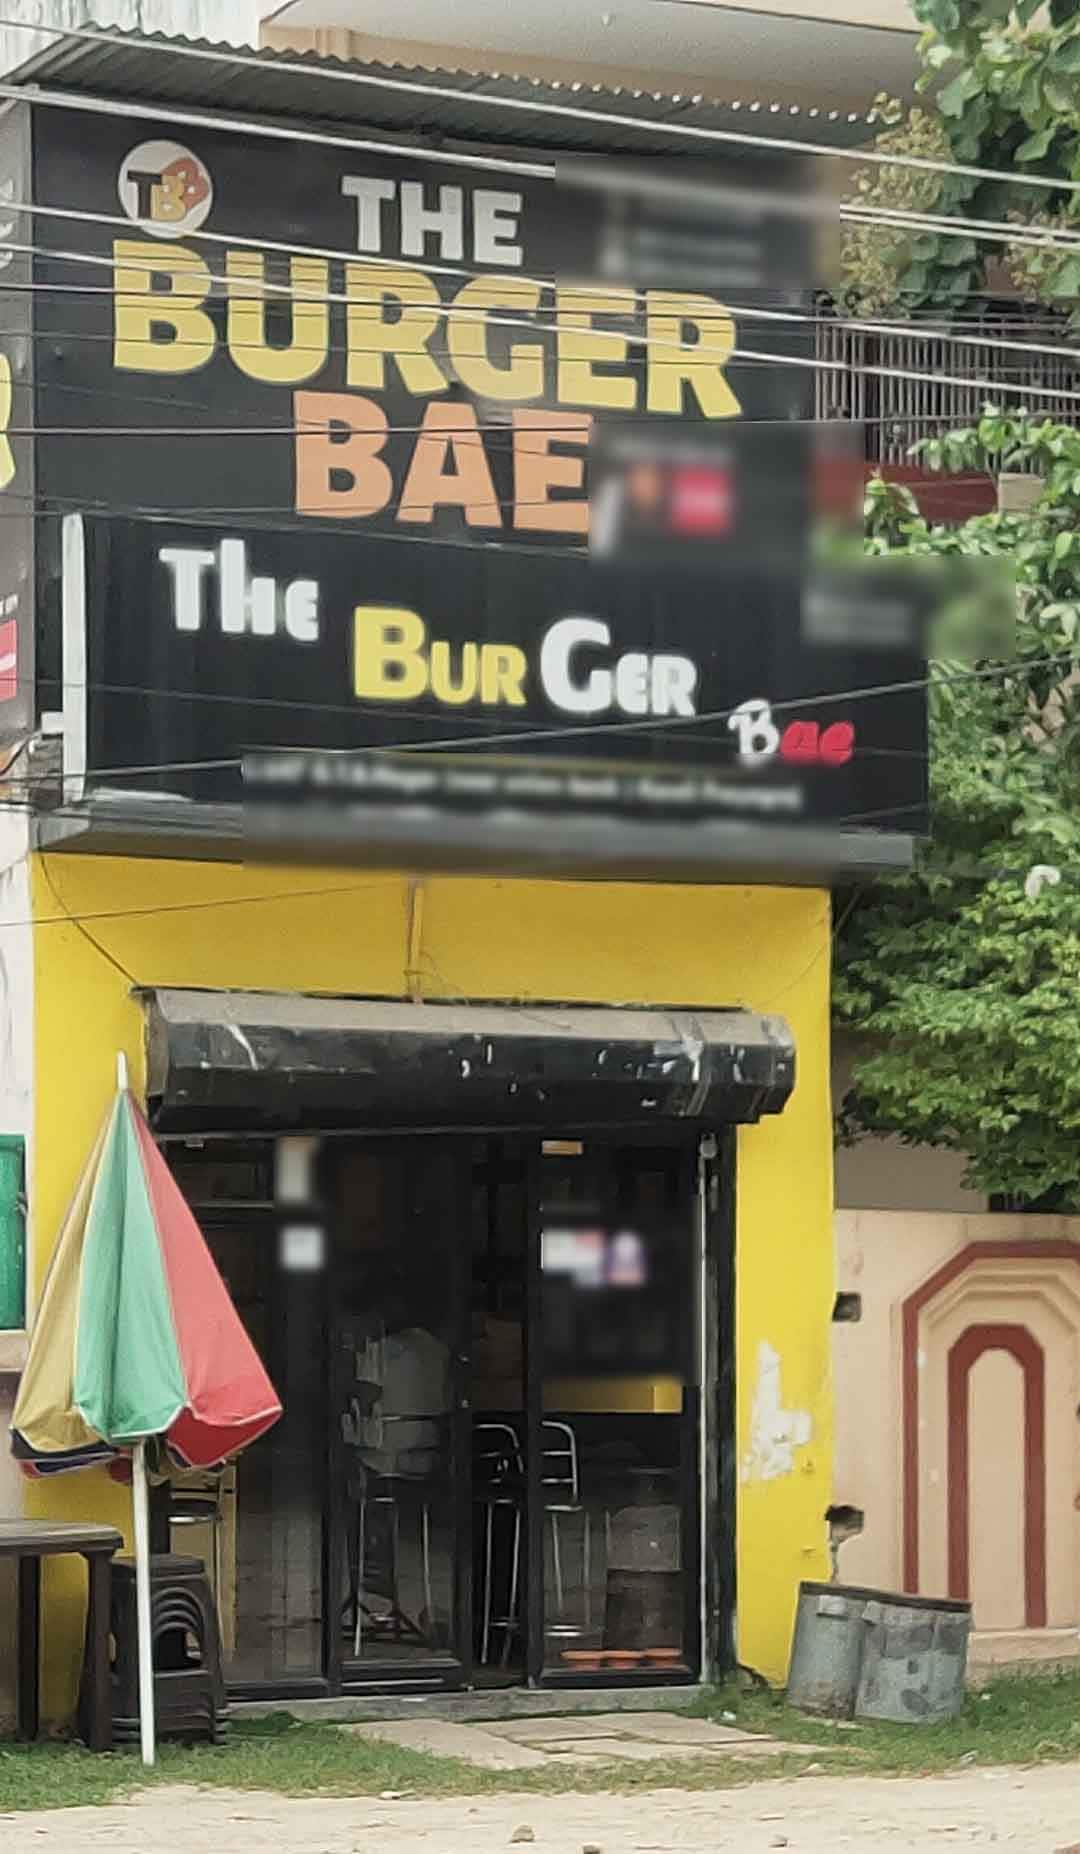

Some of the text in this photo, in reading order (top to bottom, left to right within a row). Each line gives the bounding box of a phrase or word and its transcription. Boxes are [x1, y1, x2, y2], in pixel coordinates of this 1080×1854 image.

[341, 176, 523, 266] THE
[113, 239, 742, 419] BURGER
[293, 391, 592, 536] BAE
